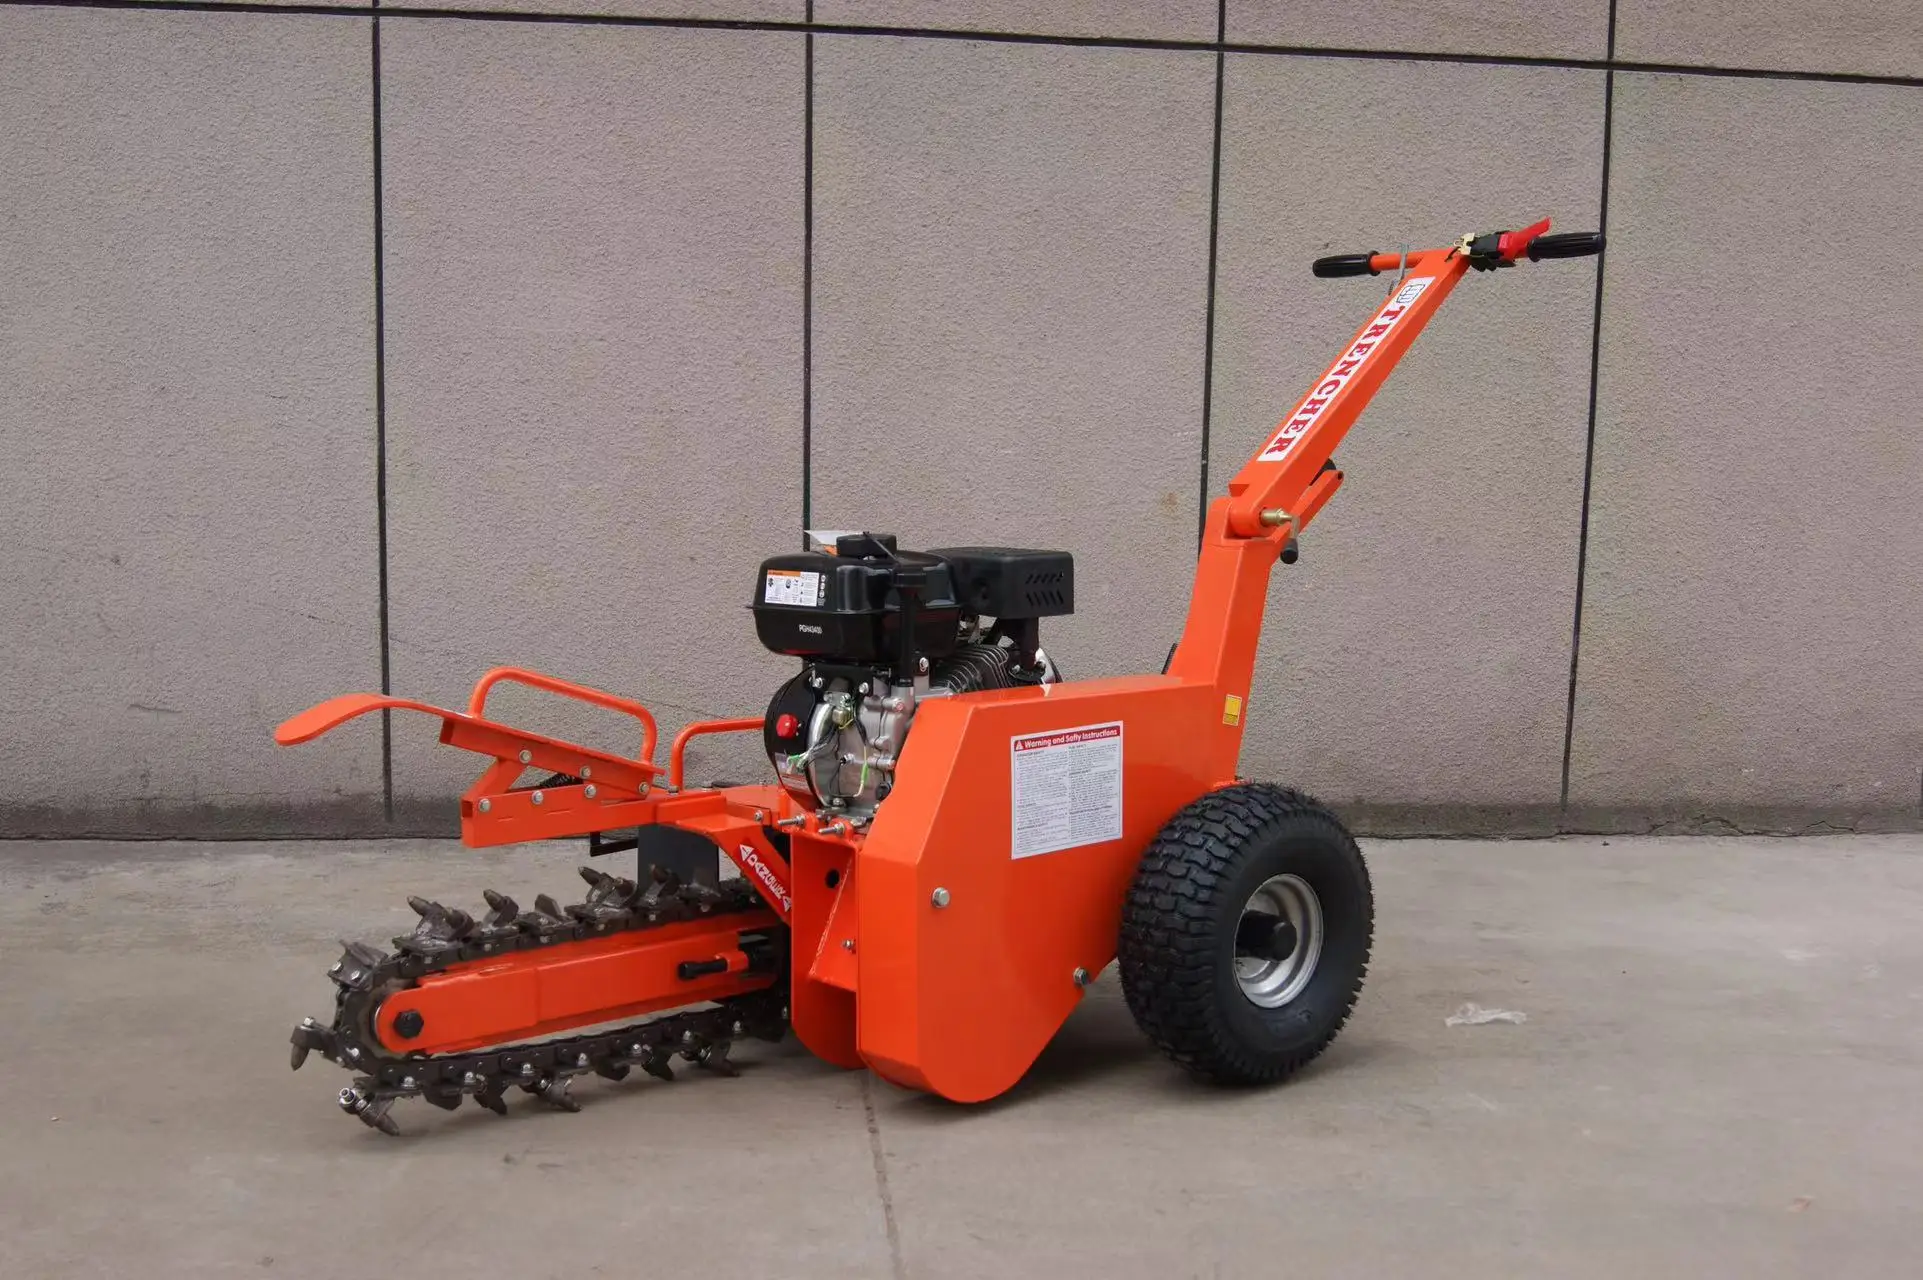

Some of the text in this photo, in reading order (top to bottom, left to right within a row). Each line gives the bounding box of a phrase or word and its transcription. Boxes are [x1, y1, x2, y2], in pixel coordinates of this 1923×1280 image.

[1266, 305, 1406, 455] TRENCHER
[1025, 739, 1052, 748] Warning
[1052, 735, 1065, 744] and
[1083, 729, 1117, 739] Instructions
[746, 853, 787, 900] DANGER
